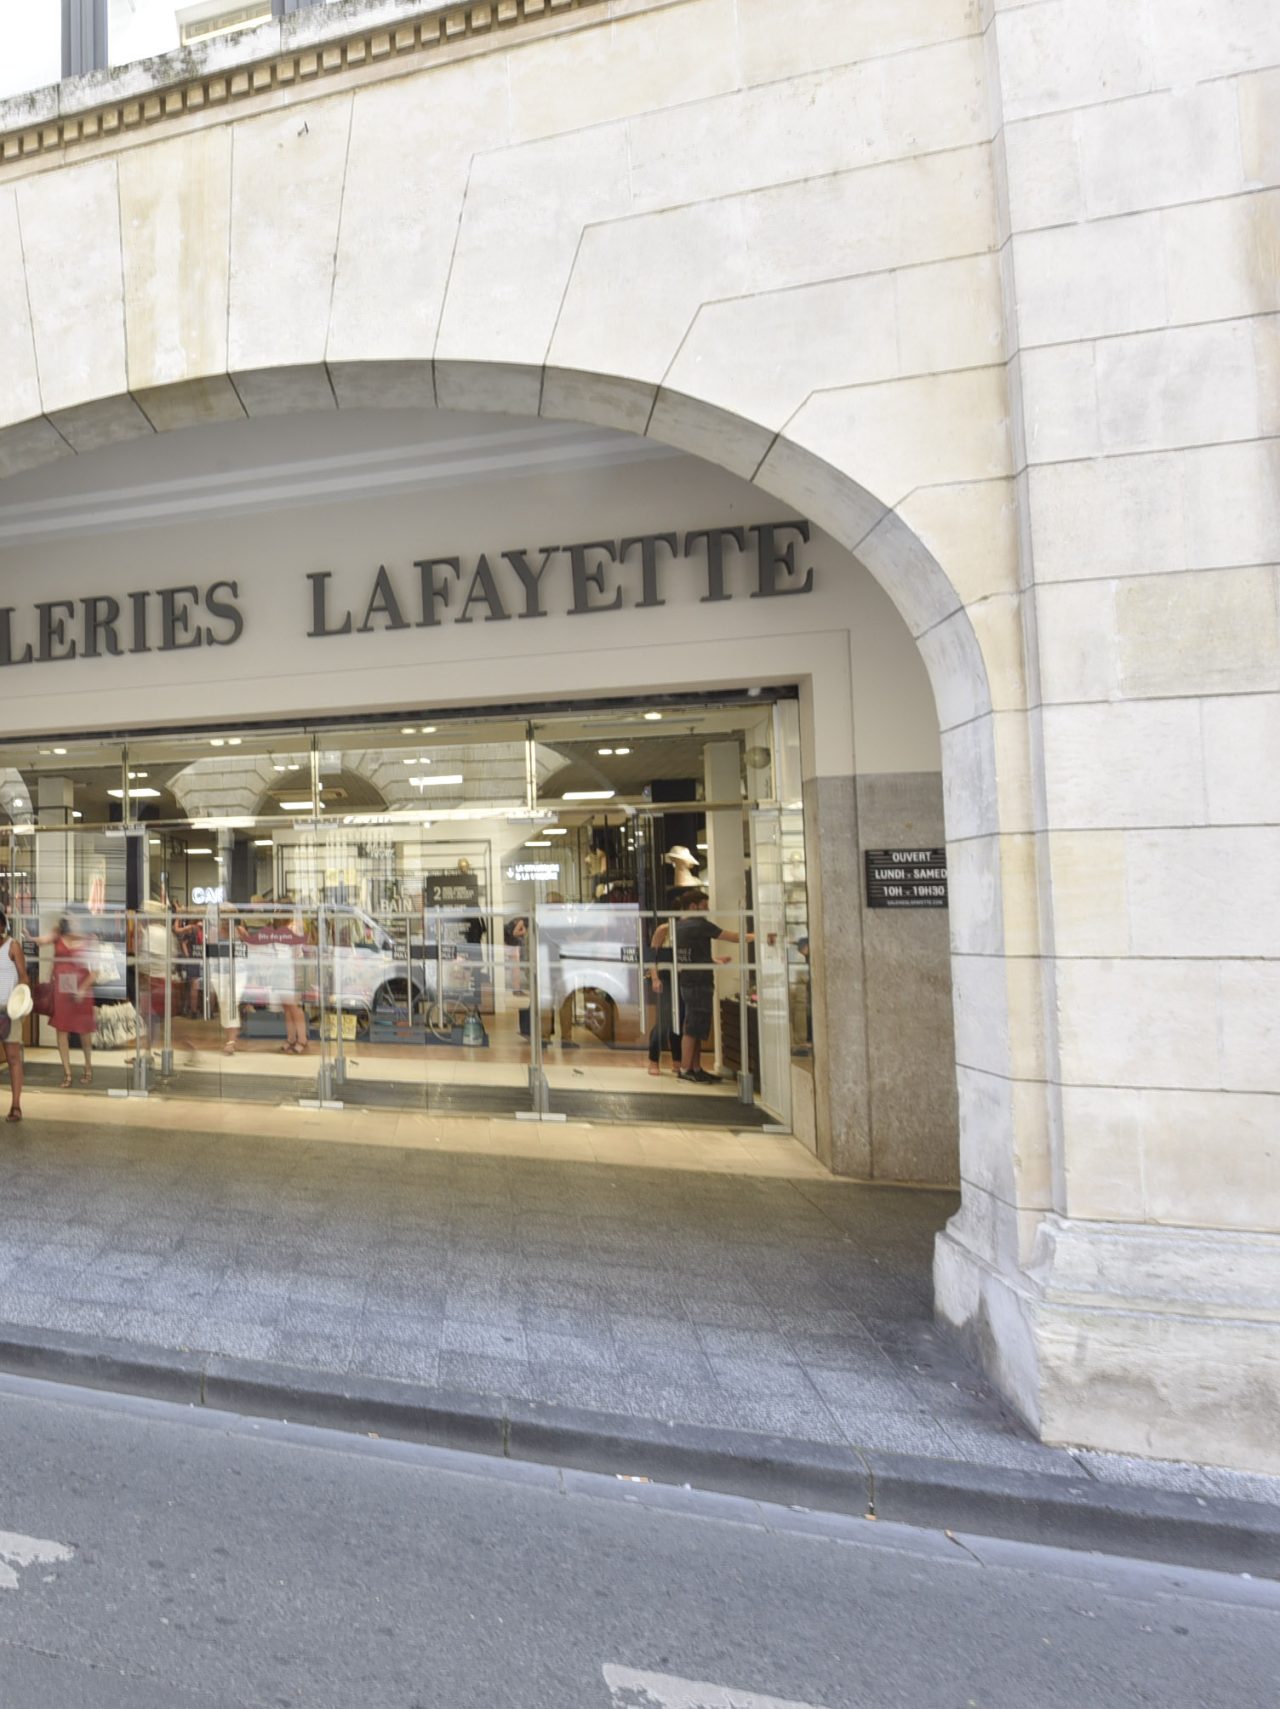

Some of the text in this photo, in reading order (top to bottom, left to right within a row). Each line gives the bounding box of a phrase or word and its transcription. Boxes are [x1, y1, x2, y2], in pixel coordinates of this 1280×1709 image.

[306, 519, 814, 639] LAFAYETTE
[892, 852, 932, 862] OUVERT
[875, 869, 947, 879] LUNDI SAMED
[883, 886, 903, 896] 10H
